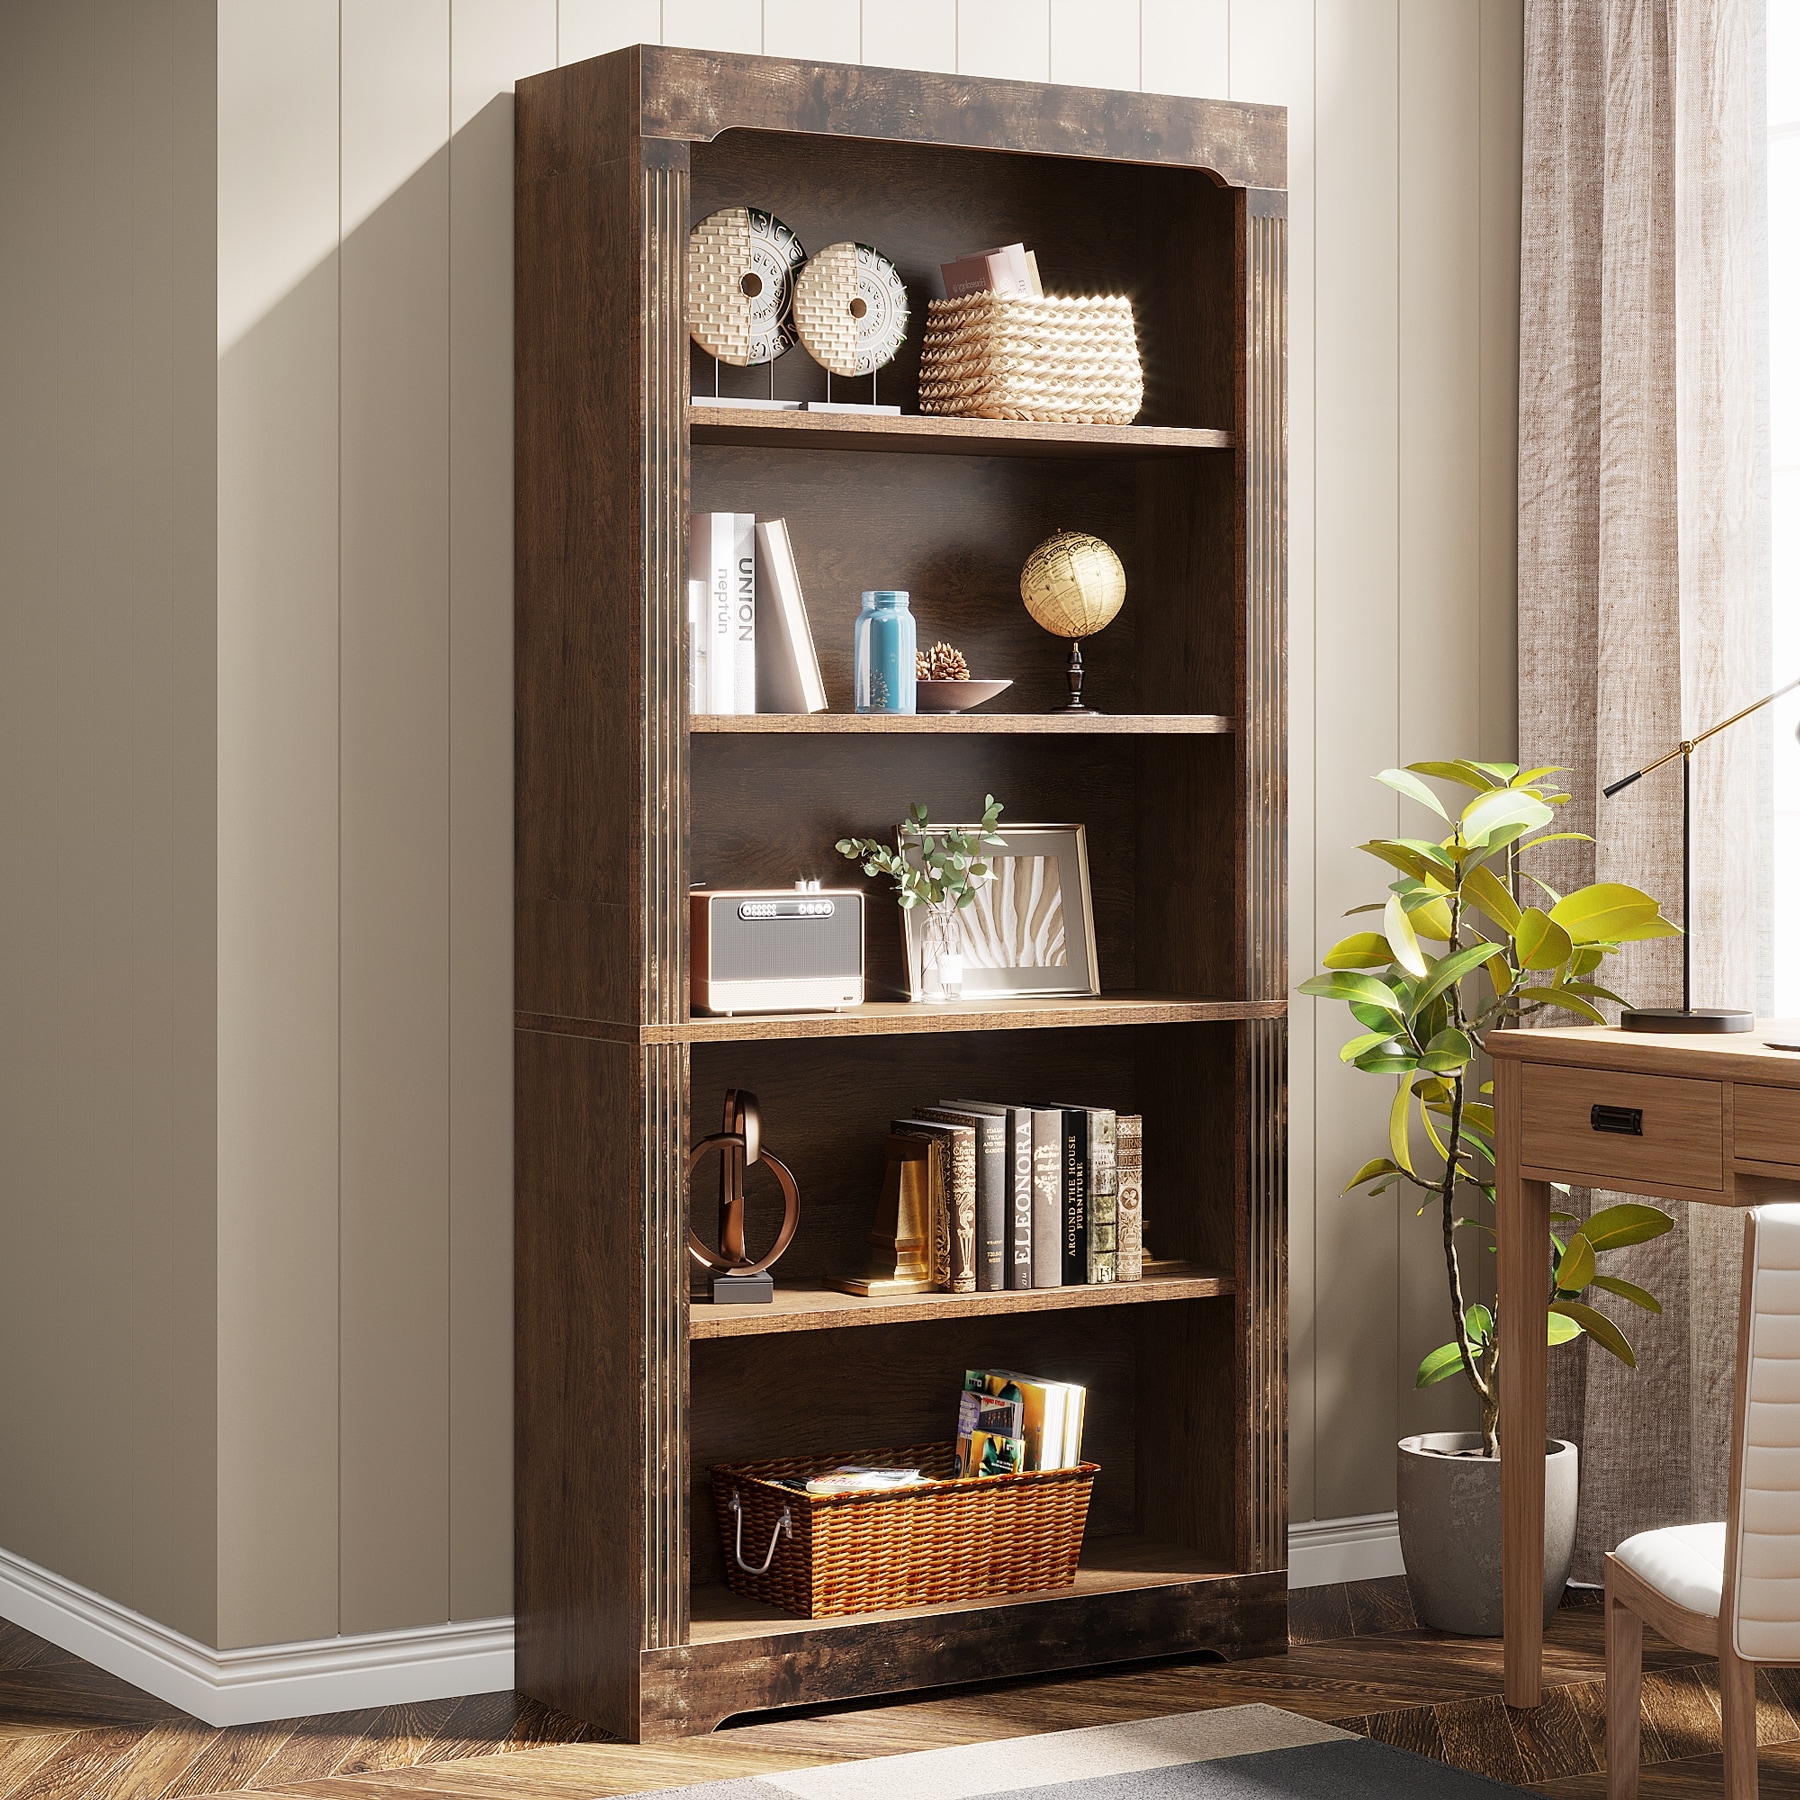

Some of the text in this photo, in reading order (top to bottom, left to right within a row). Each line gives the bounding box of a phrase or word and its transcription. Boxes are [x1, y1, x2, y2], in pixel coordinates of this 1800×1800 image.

[738, 557, 753, 642] UNION
[1014, 1121, 1031, 1265] ELEONORA
[1068, 1135, 1076, 1257] AROUND THE HOUSE
[1076, 1162, 1084, 1230] FURNITURE
